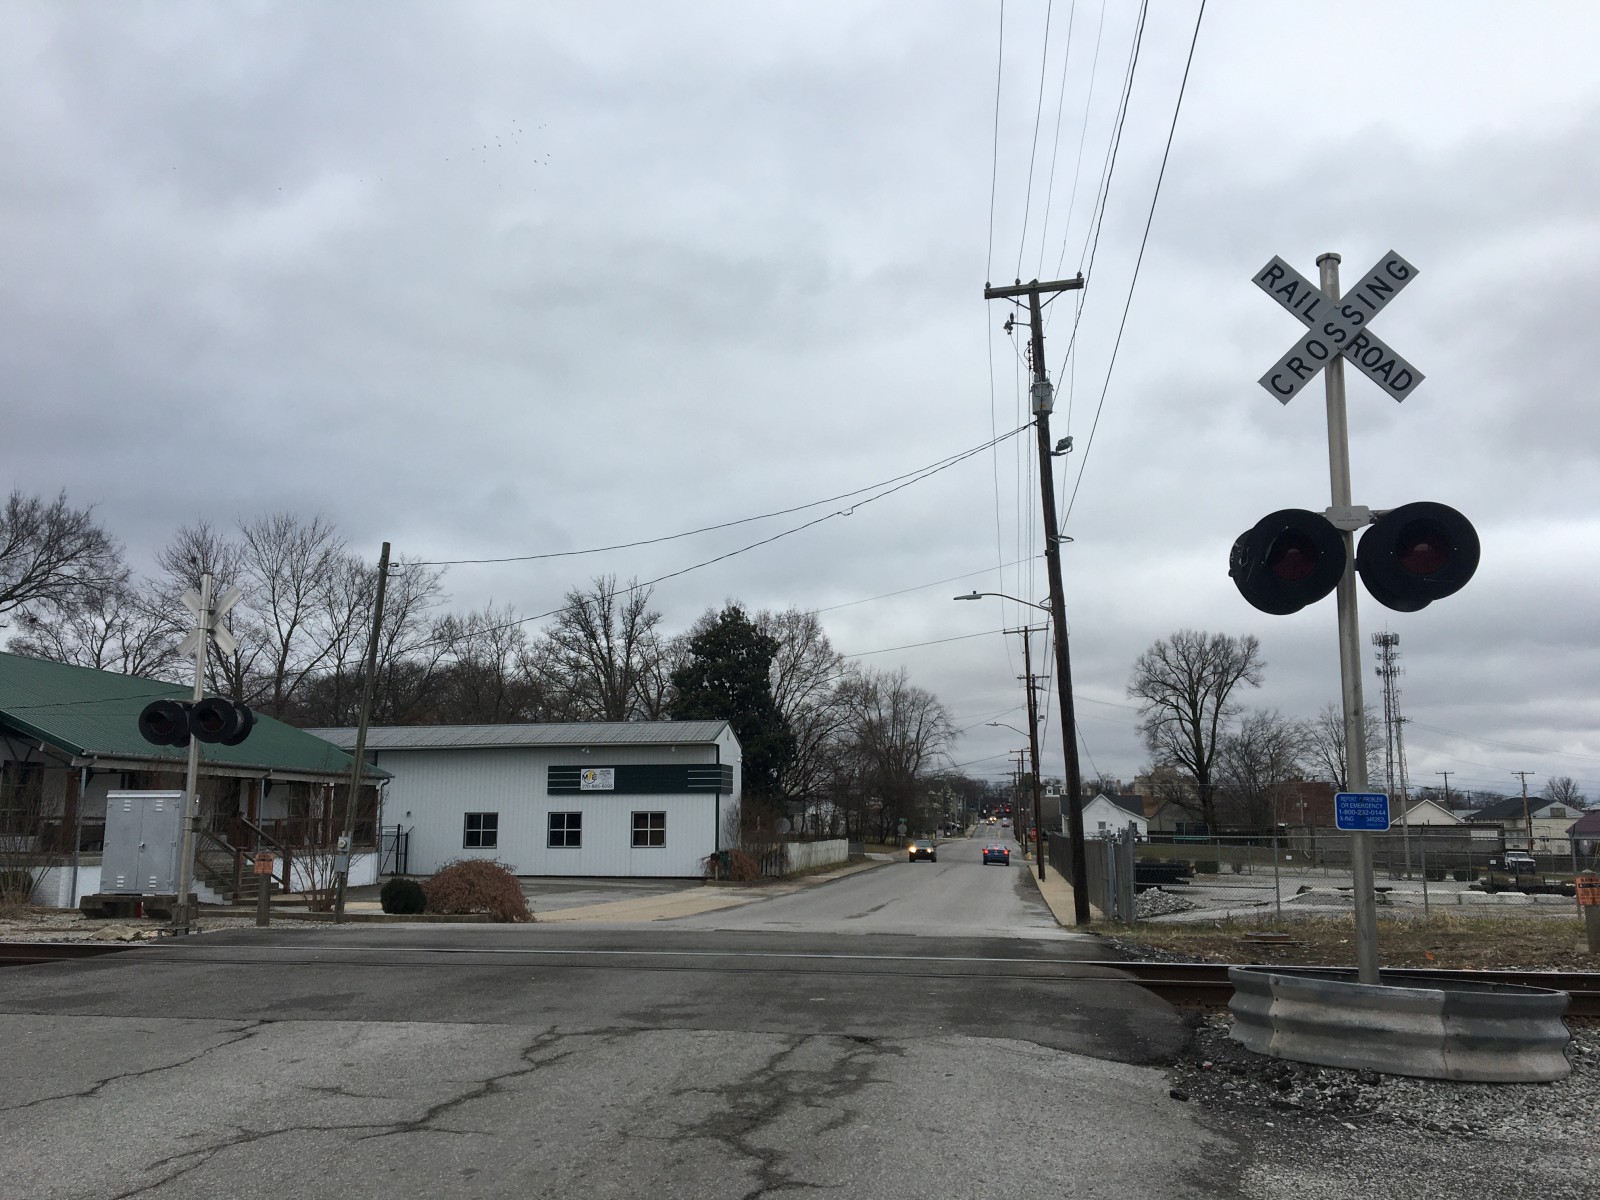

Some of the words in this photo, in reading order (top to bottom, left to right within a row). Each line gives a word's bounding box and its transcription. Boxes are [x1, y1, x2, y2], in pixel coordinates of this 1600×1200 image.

[1260, 263, 1321, 323] RAIL
[1344, 332, 1413, 392] ROAD
[1270, 260, 1410, 395] CROSSING
